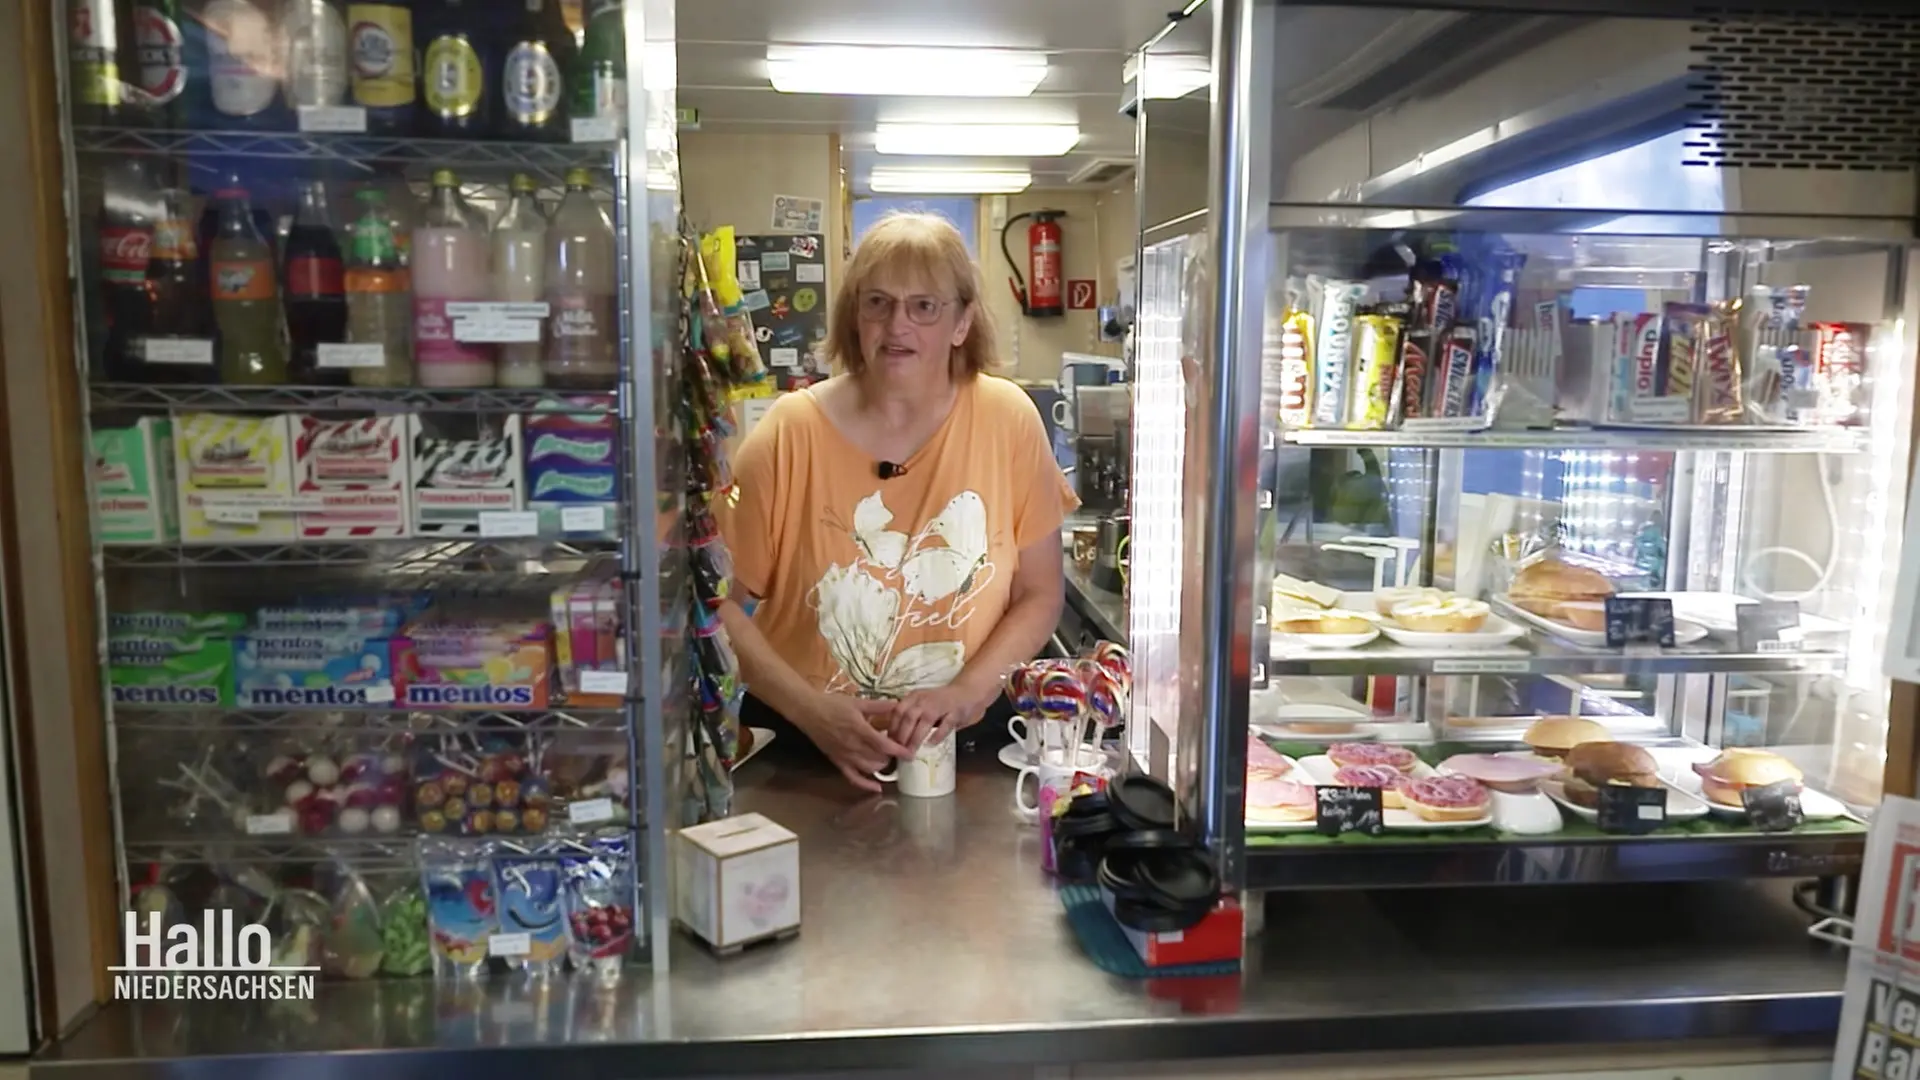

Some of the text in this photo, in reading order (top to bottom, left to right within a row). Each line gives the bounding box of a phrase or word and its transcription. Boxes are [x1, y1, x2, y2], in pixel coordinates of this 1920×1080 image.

[1635, 329, 1657, 390] duplo
[409, 684, 533, 704] mentos
[1873, 981, 1920, 1037] Ve
